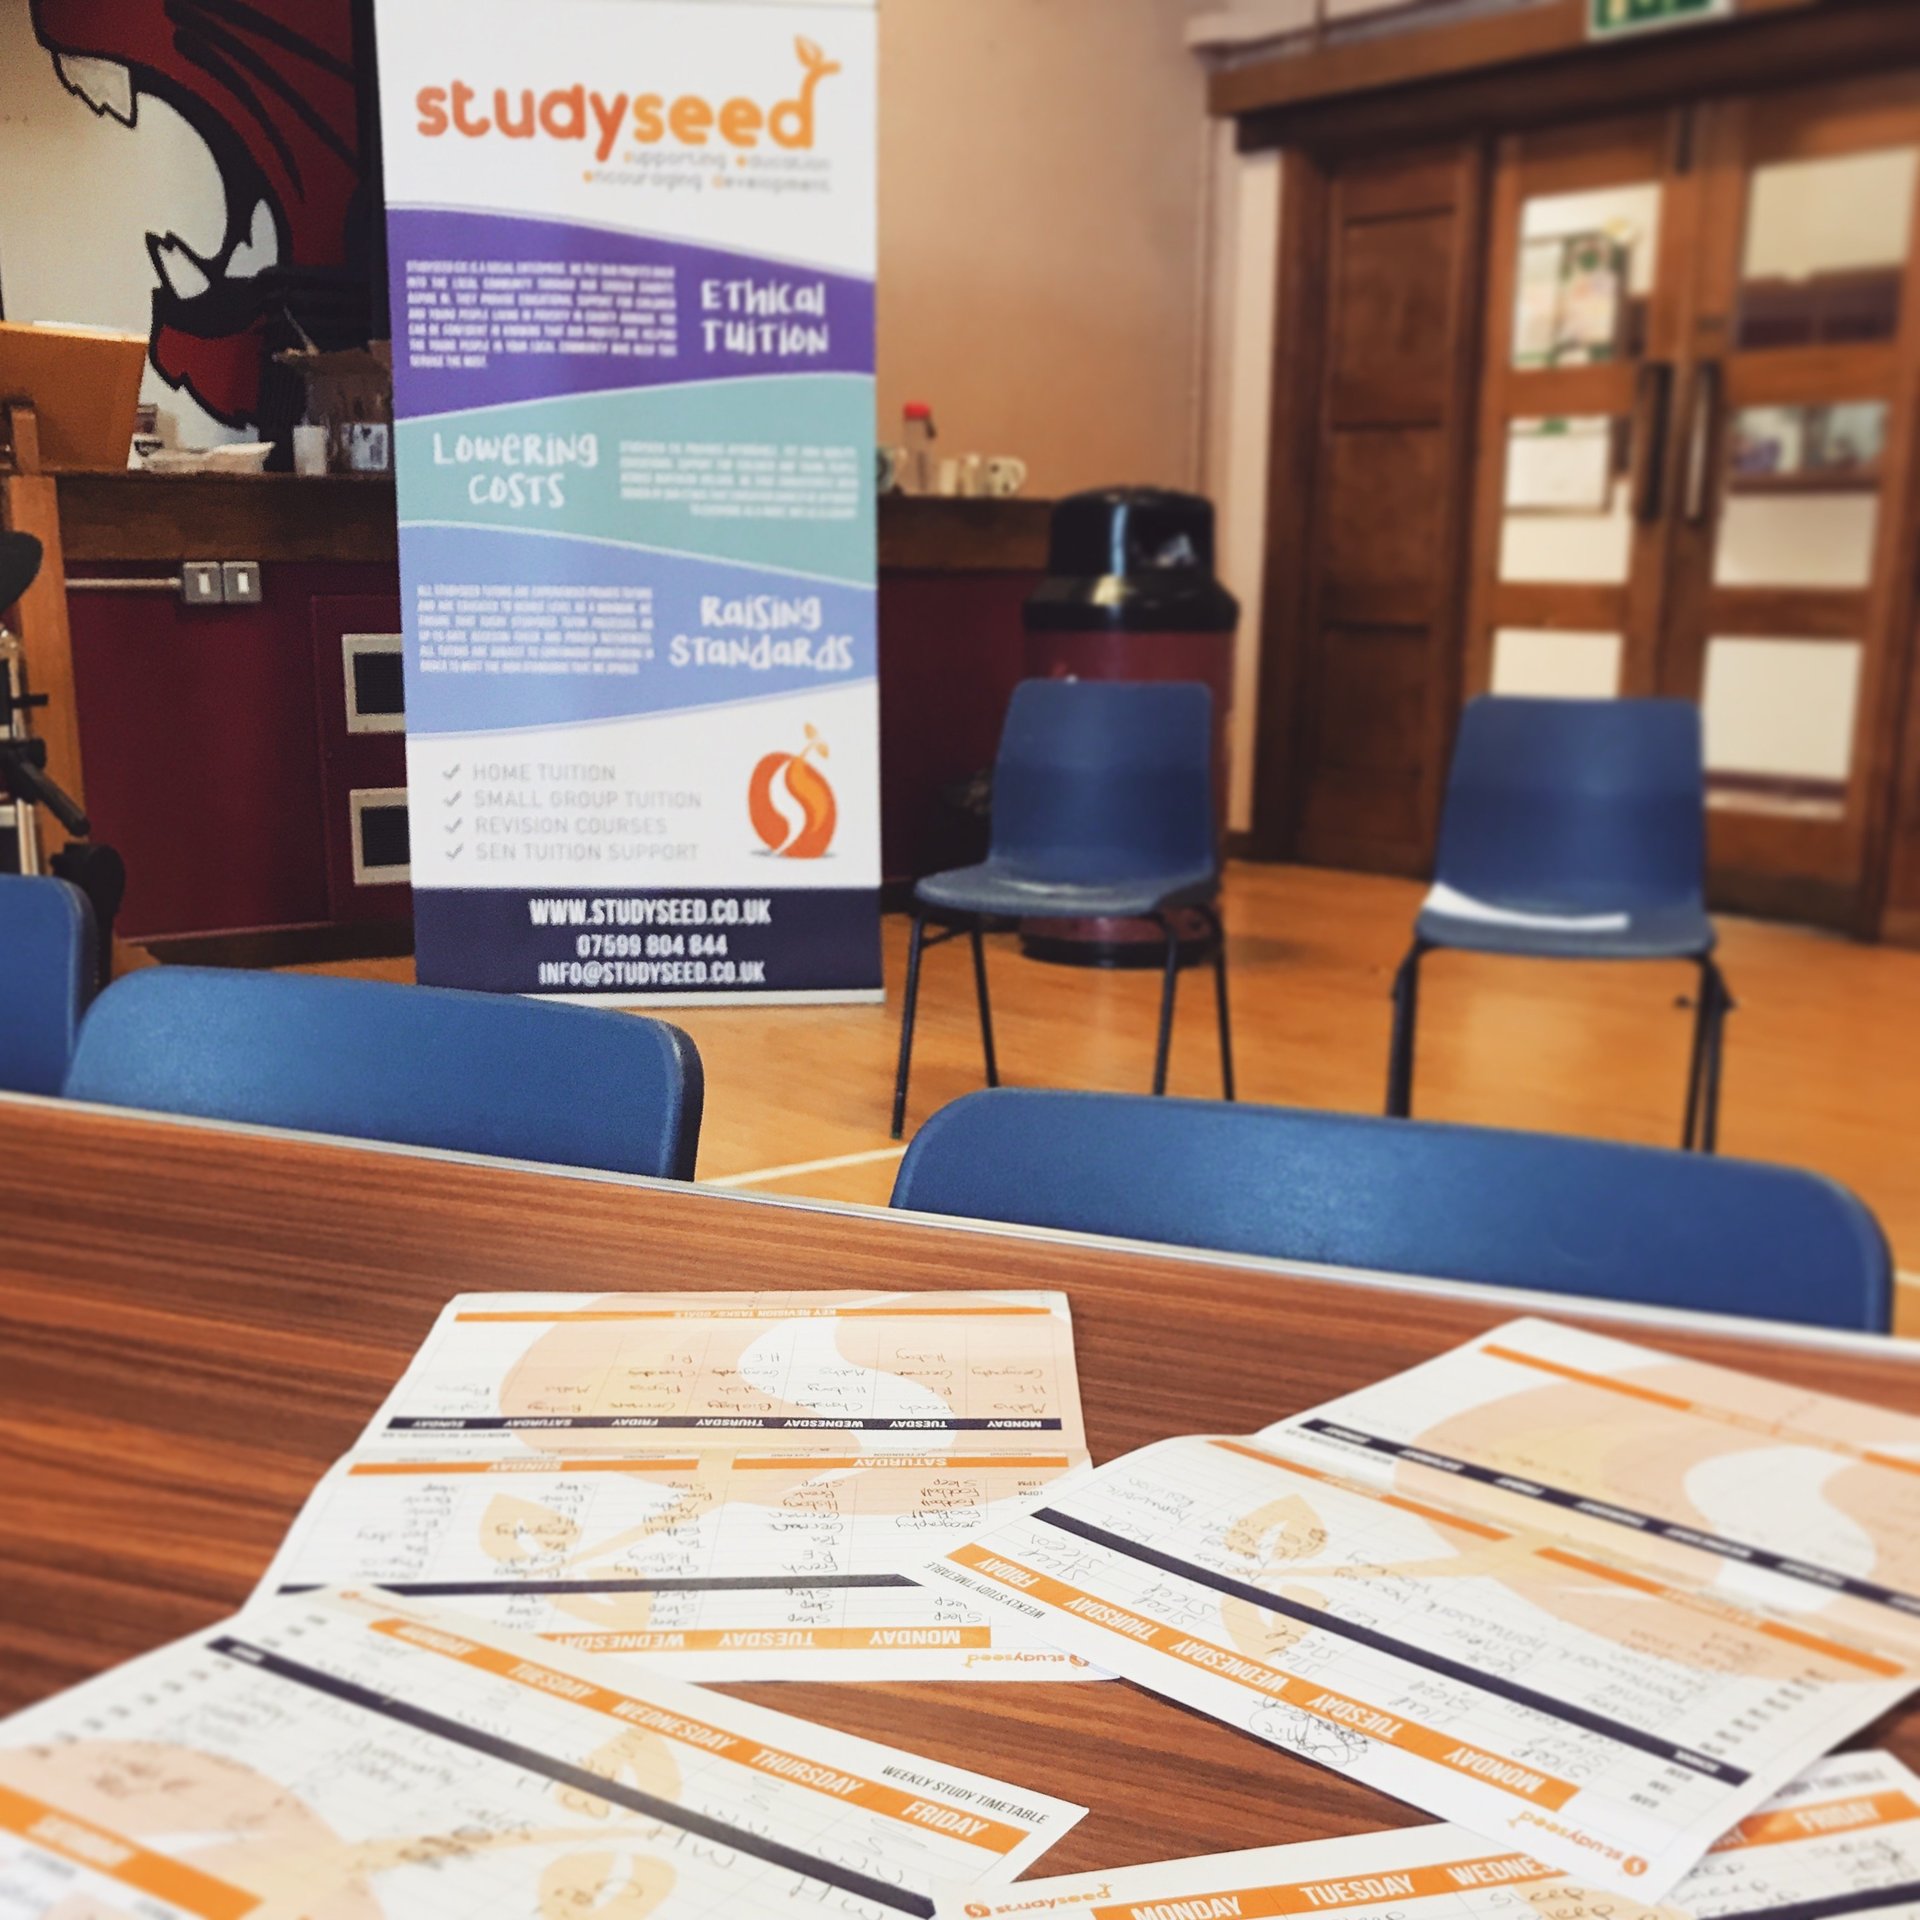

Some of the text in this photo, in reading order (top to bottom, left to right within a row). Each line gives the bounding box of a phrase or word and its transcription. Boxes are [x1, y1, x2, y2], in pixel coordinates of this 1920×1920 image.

[416, 35, 841, 162] studyseed
[468, 472, 565, 508] COSTS
[473, 763, 616, 781] HOME TUITION
[474, 790, 702, 808] SMALL GROUP TUITION
[475, 816, 668, 835] REVISION COURSES
[476, 842, 699, 861] SEN TUITION SUPPORT
[529, 898, 772, 926] WWW.STUDYSEED.CO.UK
[575, 933, 728, 957] 07599 804 844
[538, 960, 766, 986] INFO@STUDYSEED.CO.UK
[411, 1416, 1042, 1429] MONDAY TUESDAY WEDNESDAY THURSDAY FRIDAY SATURDAY SUNDAY
[852, 1458, 948, 1468] SATURDAY
[923, 1561, 1046, 1619] WEEKLY STUDY TIMETABLE
[719, 1631, 816, 1647] TUESDAY
[868, 1629, 961, 1645] MONDAY
[962, 1652, 1066, 1668] studyseed
[972, 1556, 1040, 1588] FRIDAY
[1062, 1595, 1161, 1641] THURSDAY
[1167, 1637, 1290, 1693] WEDNESDAY
[1305, 1692, 1406, 1739] TUESDAY
[1442, 1745, 1546, 1794] MONDAY
[508, 1663, 598, 1699] TUESDAY
[611, 1700, 738, 1749] WEDNESDAY
[750, 1749, 864, 1796] THURSDAY
[901, 1800, 989, 1838] FRIDAY
[881, 1765, 1049, 1824] WEEKLY STUDY TIMETABLE
[1506, 1811, 1624, 1861] studyseed
[995, 1883, 1113, 1915] studyseed
[1130, 1896, 1244, 1920] MONDAY
[1299, 1874, 1416, 1907] TUESDAY
